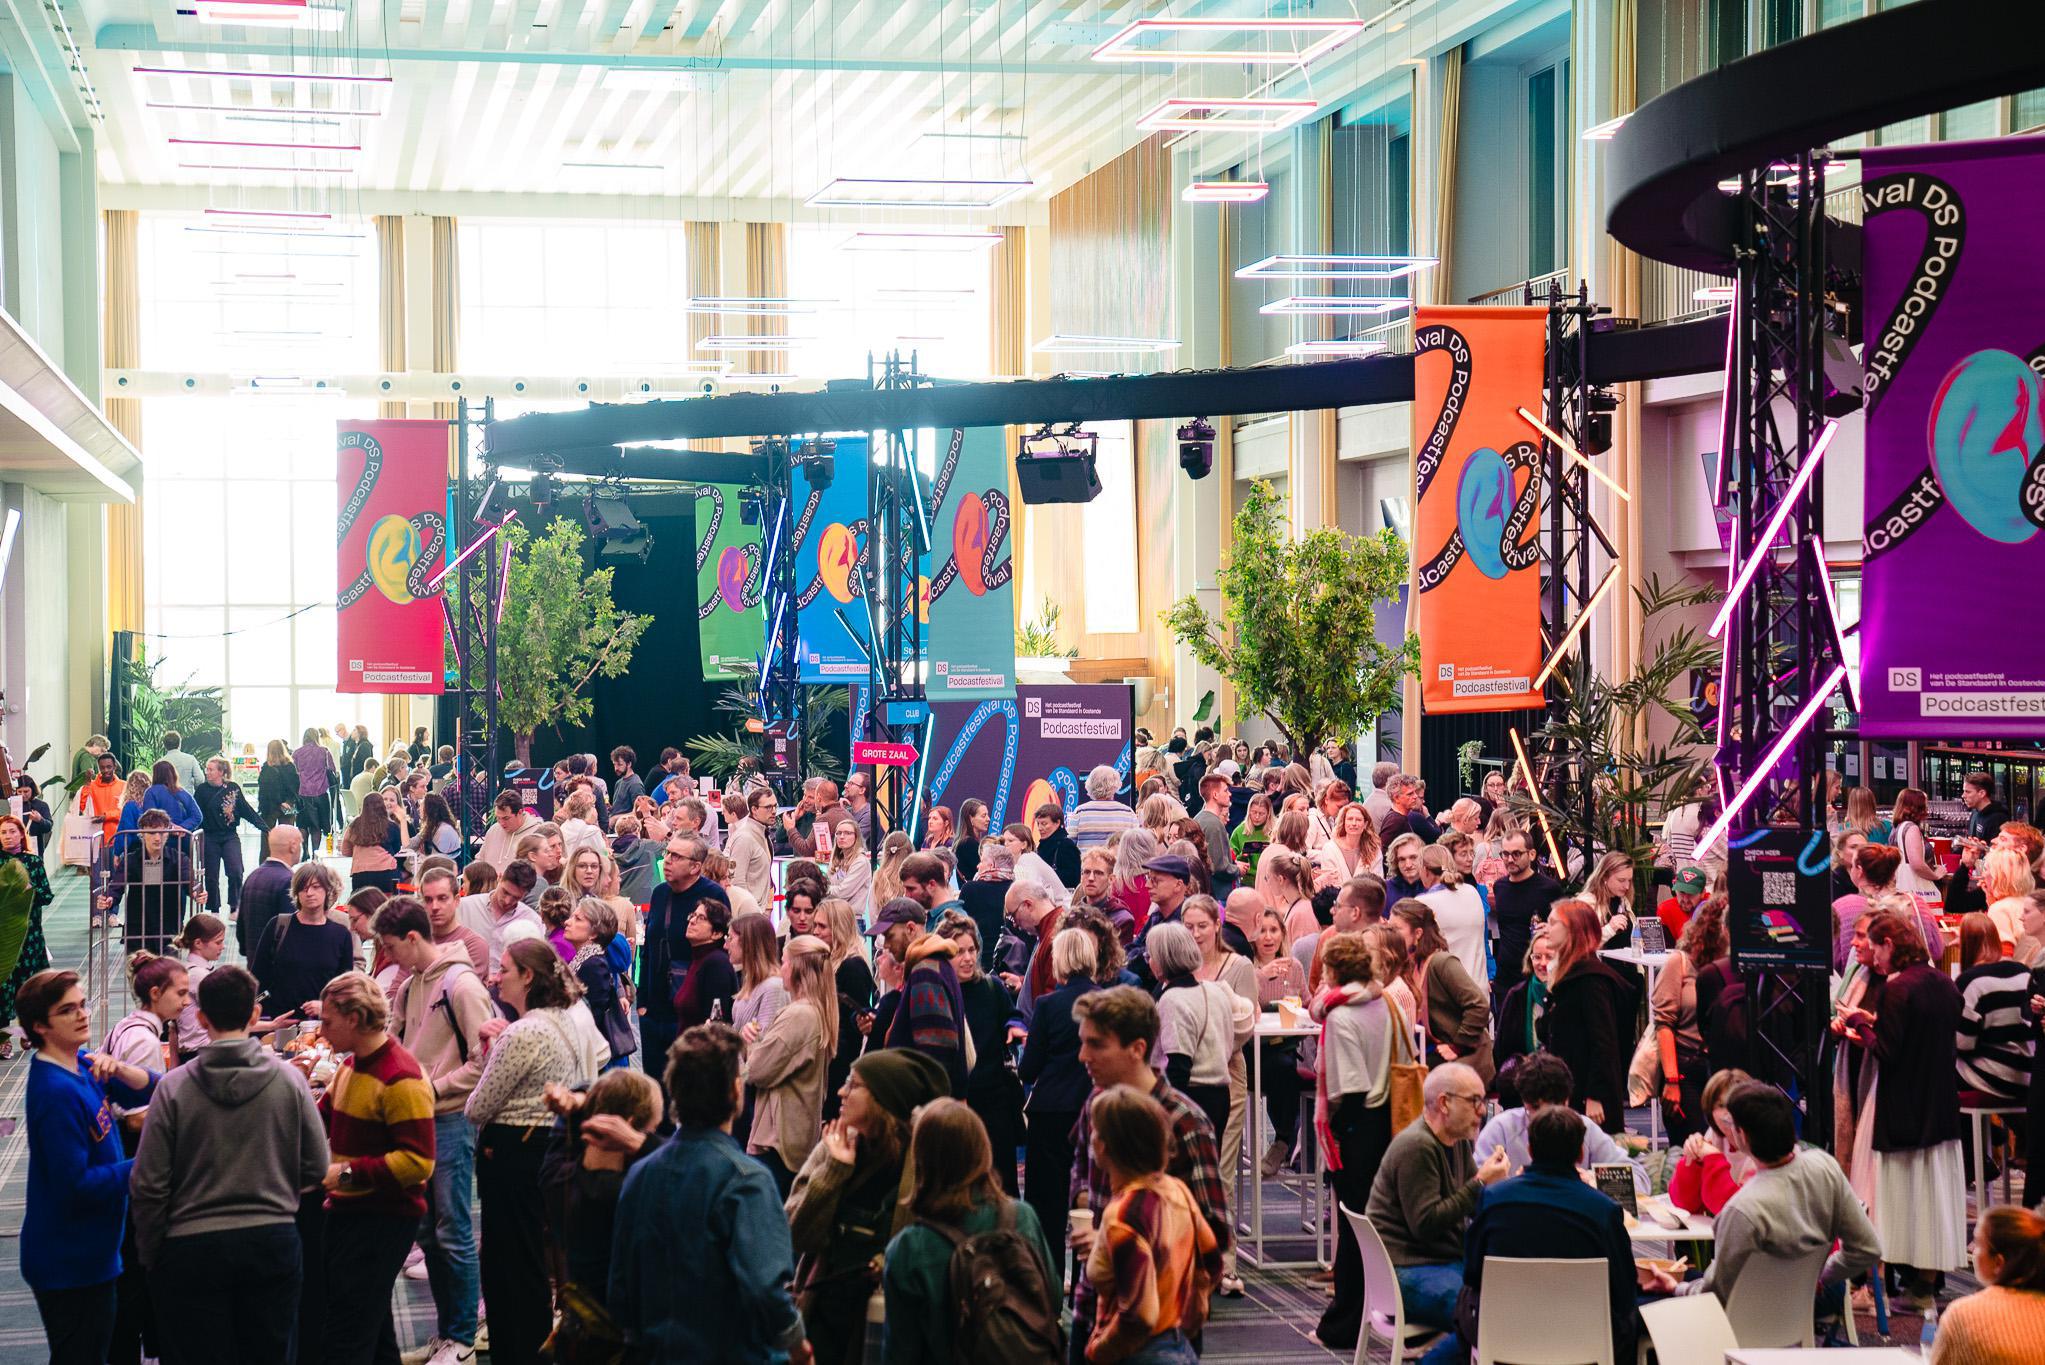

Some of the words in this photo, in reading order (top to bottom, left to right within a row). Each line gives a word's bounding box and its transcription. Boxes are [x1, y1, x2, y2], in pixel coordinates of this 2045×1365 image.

[1922, 184, 1959, 226] DS
[1449, 334, 1469, 364] DS
[363, 438, 380, 458] DS
[712, 489, 723, 504] DS
[982, 492, 1010, 588] Podcastfestival
[408, 514, 446, 596] Podcastfestival
[351, 661, 362, 669] DS
[820, 664, 869, 673] Podcastfestiva
[937, 664, 947, 673] DS
[364, 673, 431, 681] Podcastfestival
[1440, 667, 1453, 678] DS
[1893, 672, 1918, 687] DS
[949, 677, 1003, 686] Podcastfestival
[1455, 680, 1528, 694] Podcastfestival
[905, 709, 920, 718] CLUB
[1027, 701, 1040, 714] DS
[1043, 721, 1119, 735] Podcastfestival
[936, 700, 1000, 790] Podcastfestival
[862, 749, 887, 759] GROTE
[888, 750, 909, 760] ZAAL
